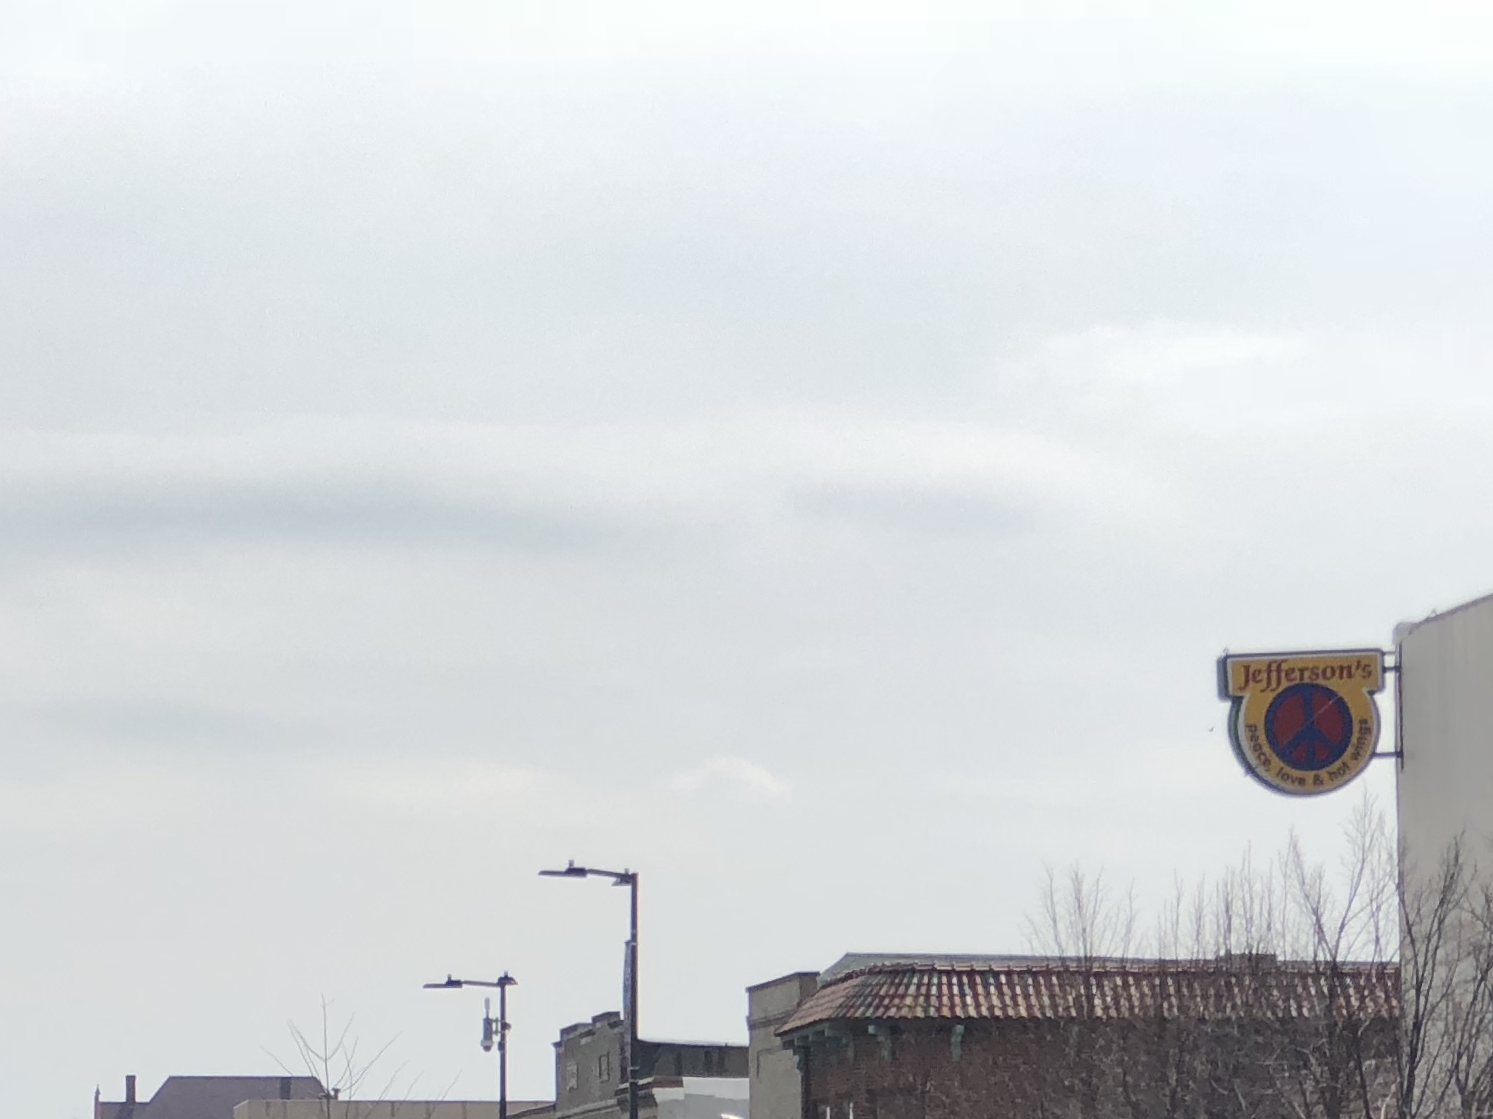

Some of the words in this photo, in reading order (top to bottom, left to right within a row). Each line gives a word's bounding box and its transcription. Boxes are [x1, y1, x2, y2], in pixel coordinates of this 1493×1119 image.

[1238, 659, 1372, 693] Jefferson's
[1275, 767, 1307, 787] love
[1313, 774, 1324, 786] &
[1326, 762, 1351, 782] hot
[1350, 718, 1372, 761] wings
